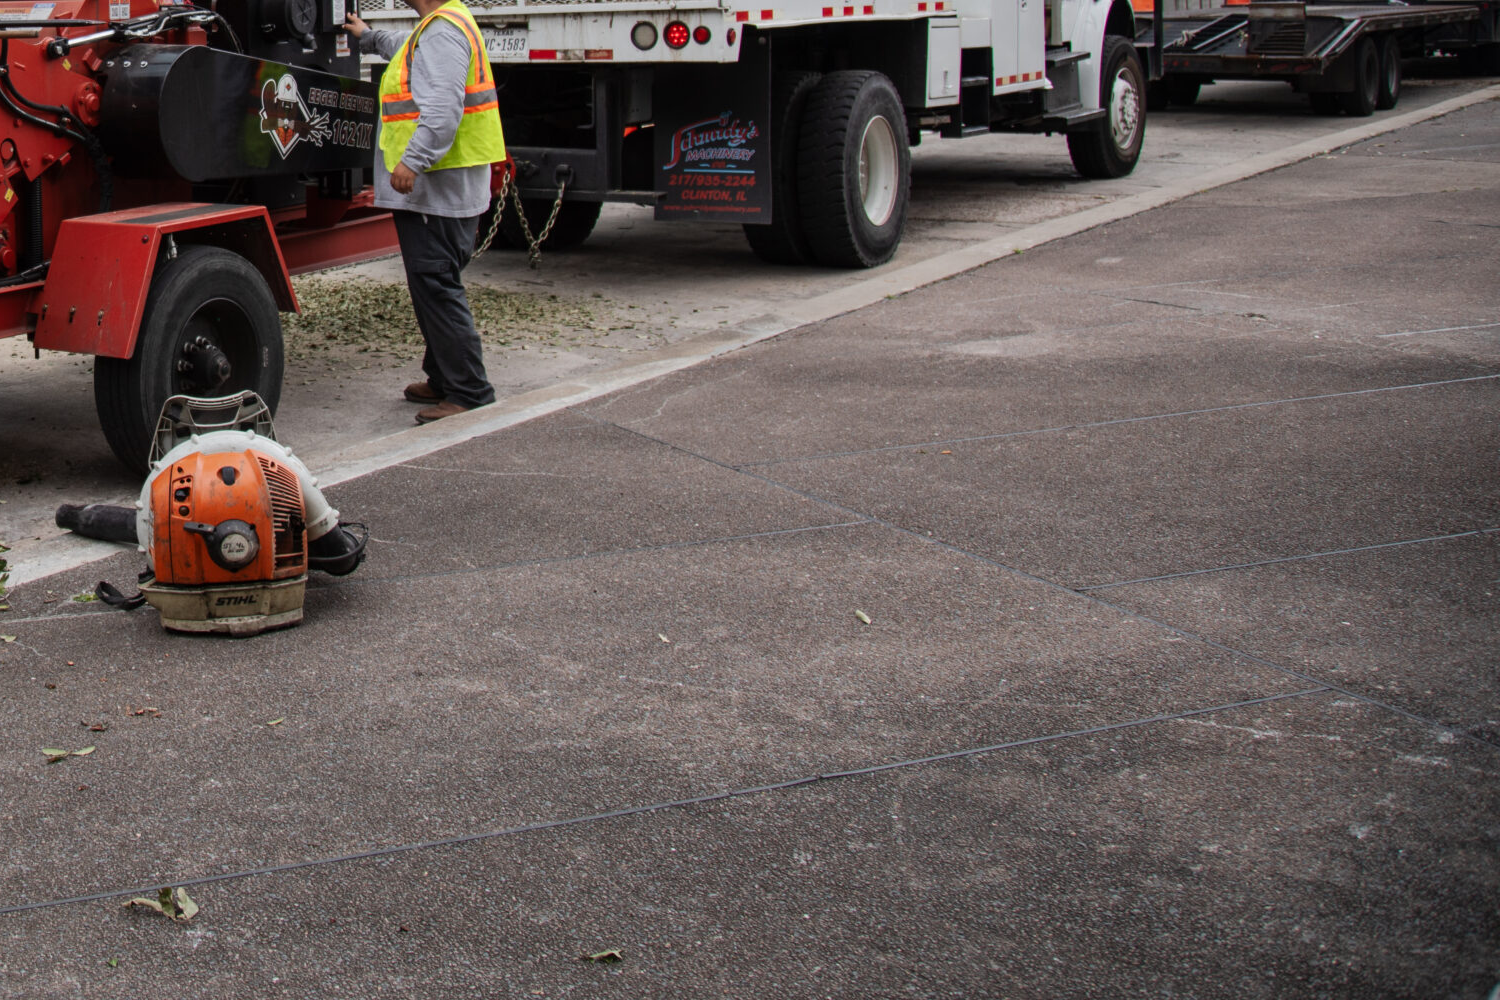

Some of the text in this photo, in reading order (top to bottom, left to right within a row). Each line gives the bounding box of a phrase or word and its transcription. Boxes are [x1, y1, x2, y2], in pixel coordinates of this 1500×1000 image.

[308, 87, 375, 114] EEGER BEEVER
[332, 119, 373, 149] 1621X
[685, 148, 756, 162] MACHINERY
[668, 174, 756, 187] 217/935-2244
[681, 189, 748, 202] CLINTON, IL
[215, 594, 257, 606] STIHL
